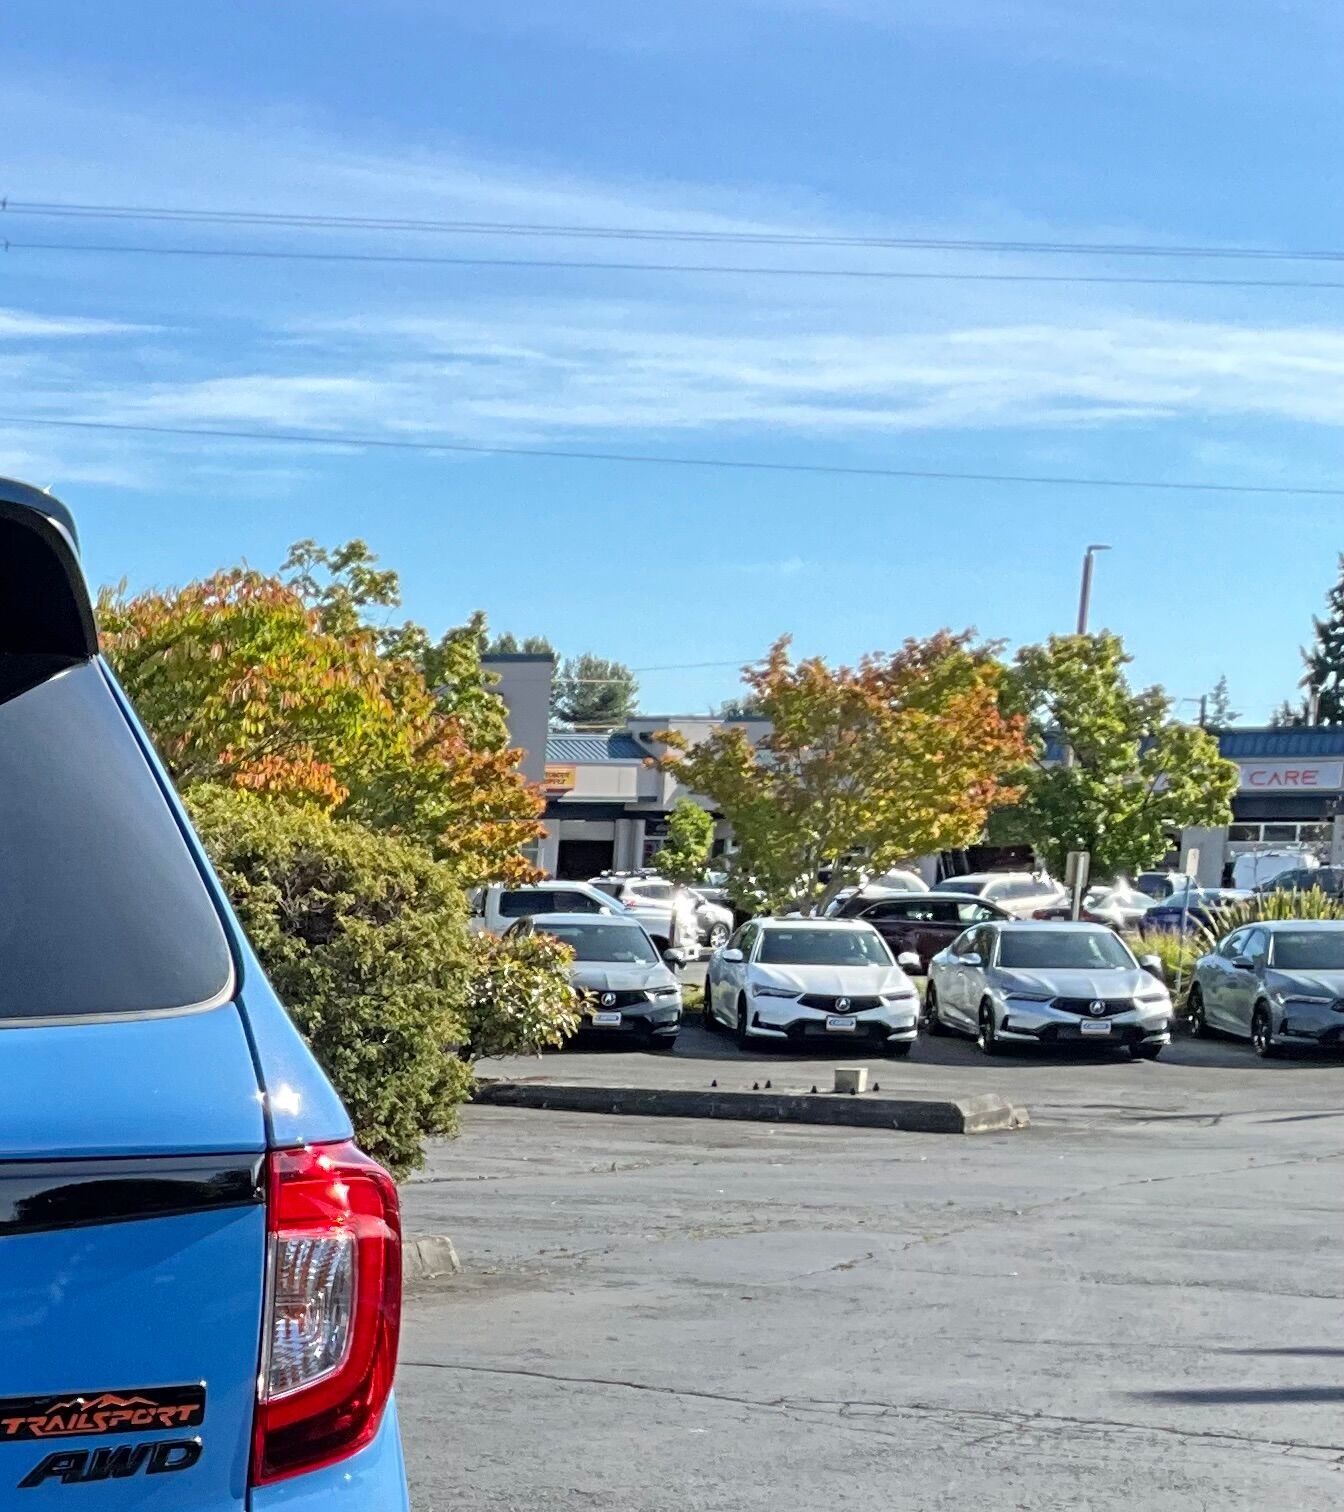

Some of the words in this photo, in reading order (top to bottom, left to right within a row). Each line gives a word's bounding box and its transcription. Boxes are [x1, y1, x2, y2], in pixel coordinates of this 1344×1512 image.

[1248, 769, 1320, 786] CARE
[0, 1404, 200, 1436] TRAILSPORT
[16, 1437, 203, 1489] AWD
